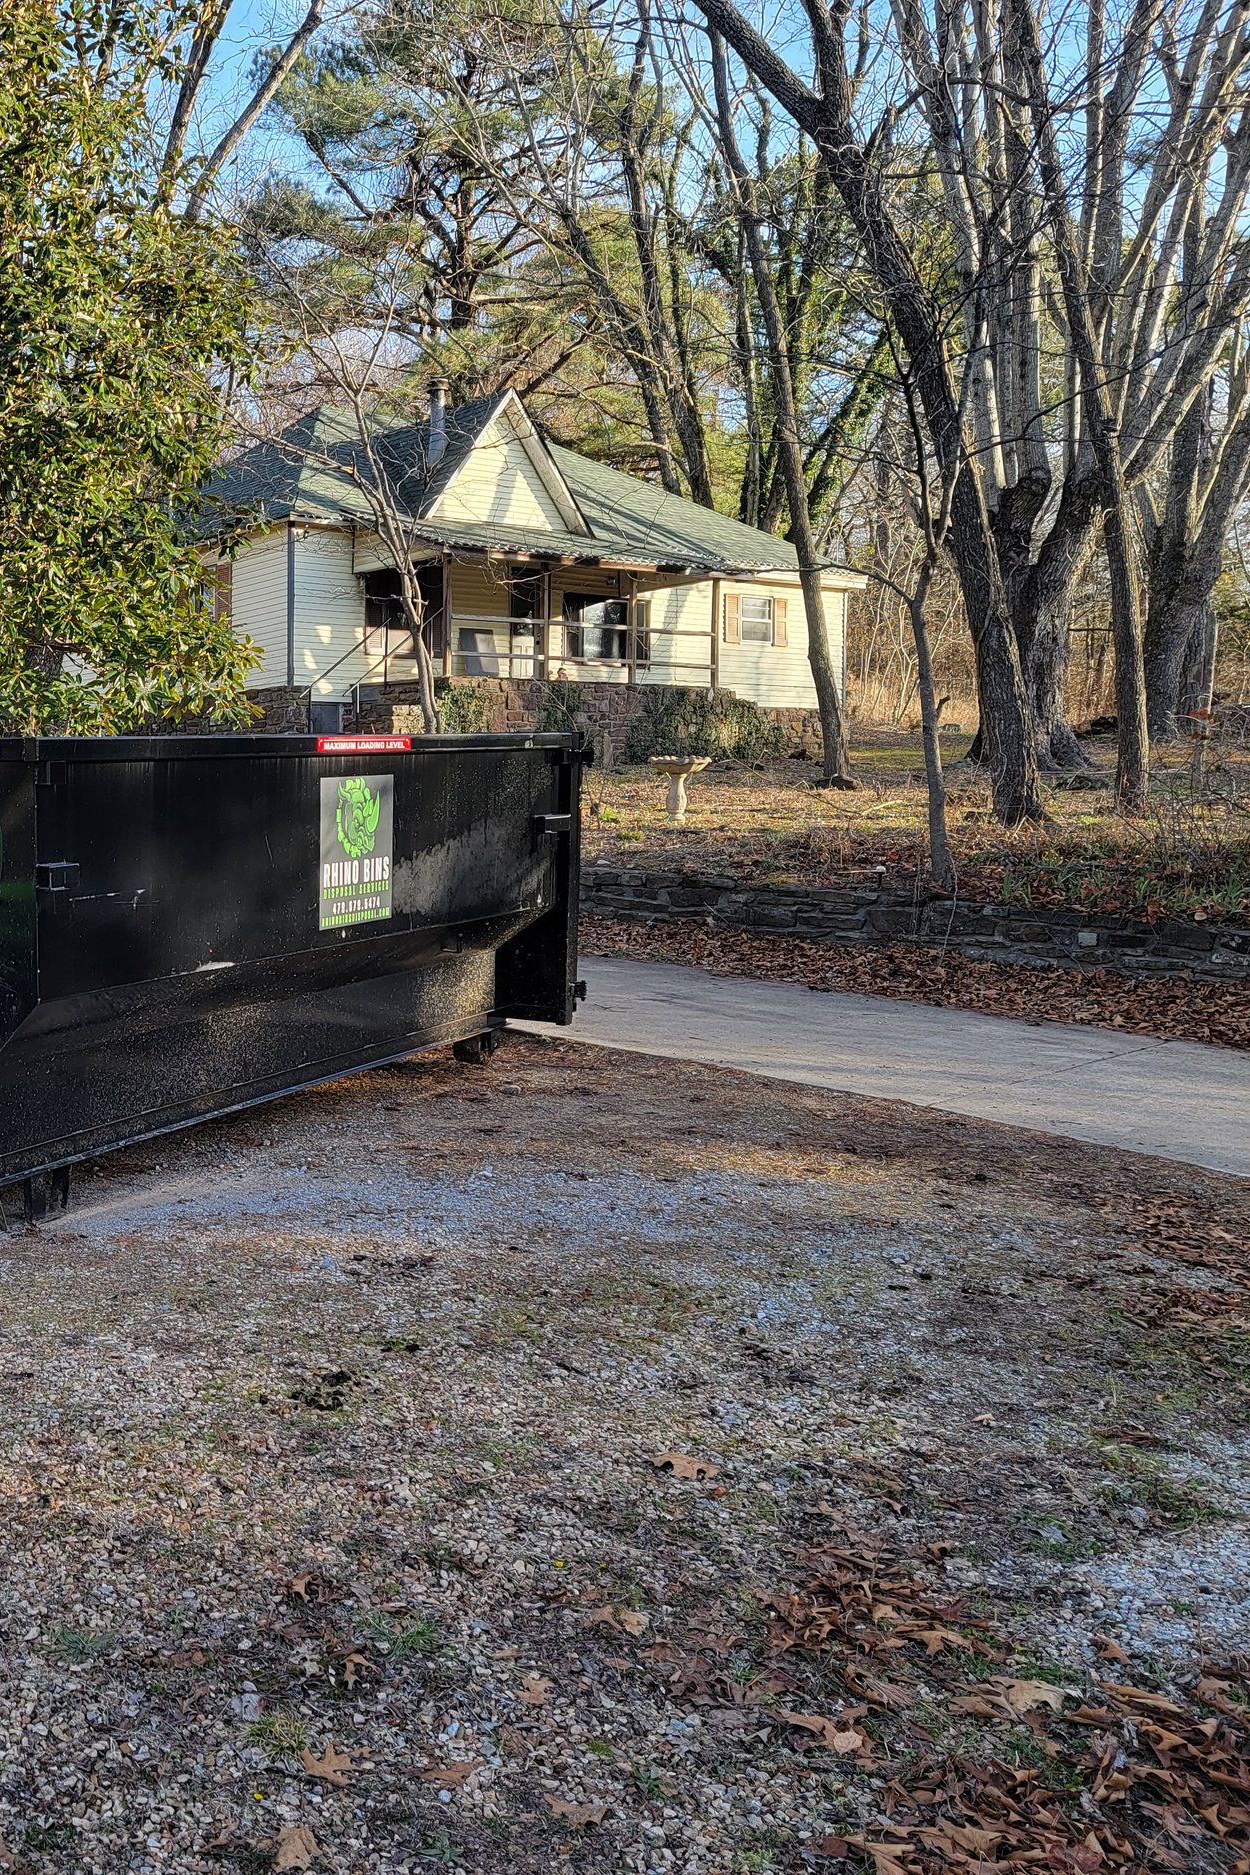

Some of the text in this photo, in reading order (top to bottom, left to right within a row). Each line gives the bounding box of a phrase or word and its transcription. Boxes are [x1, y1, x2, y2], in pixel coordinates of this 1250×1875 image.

[324, 741, 405, 750] MAXIMUM LOADING LEVEL
[323, 856, 390, 888] RHINO BINS
[323, 880, 389, 900] DISPOSAL SERVICES
